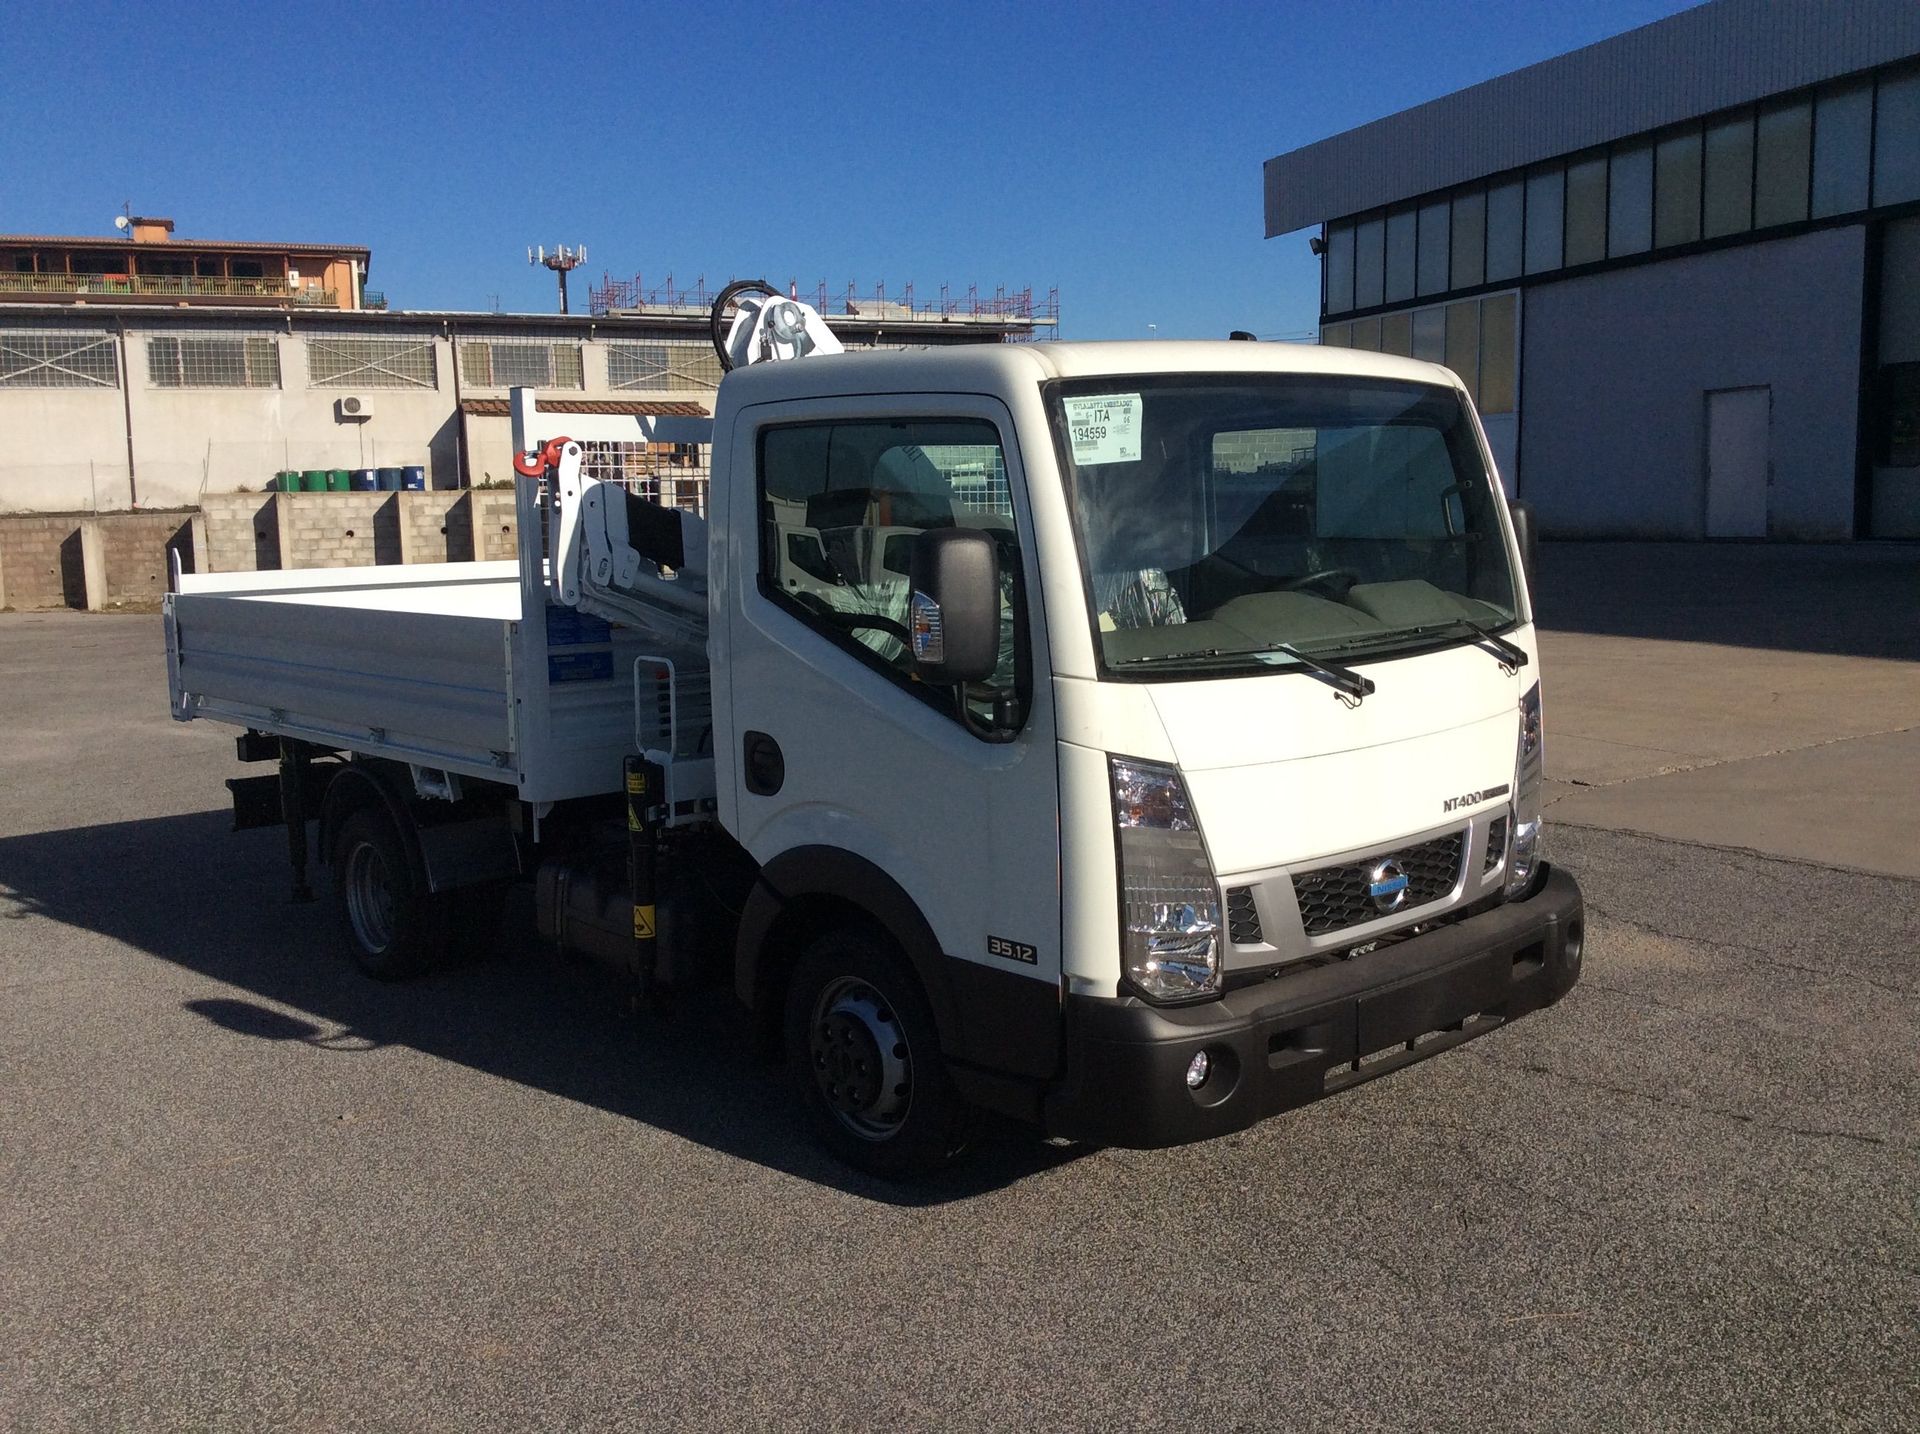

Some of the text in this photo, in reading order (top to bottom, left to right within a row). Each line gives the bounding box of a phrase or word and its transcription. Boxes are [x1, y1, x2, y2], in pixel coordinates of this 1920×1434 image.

[1094, 409, 1110, 423] ITA
[1073, 426, 1107, 441] 194559
[1443, 791, 1482, 813] NT400
[1376, 880, 1404, 894] NIS
[991, 938, 1033, 961] 35.12
